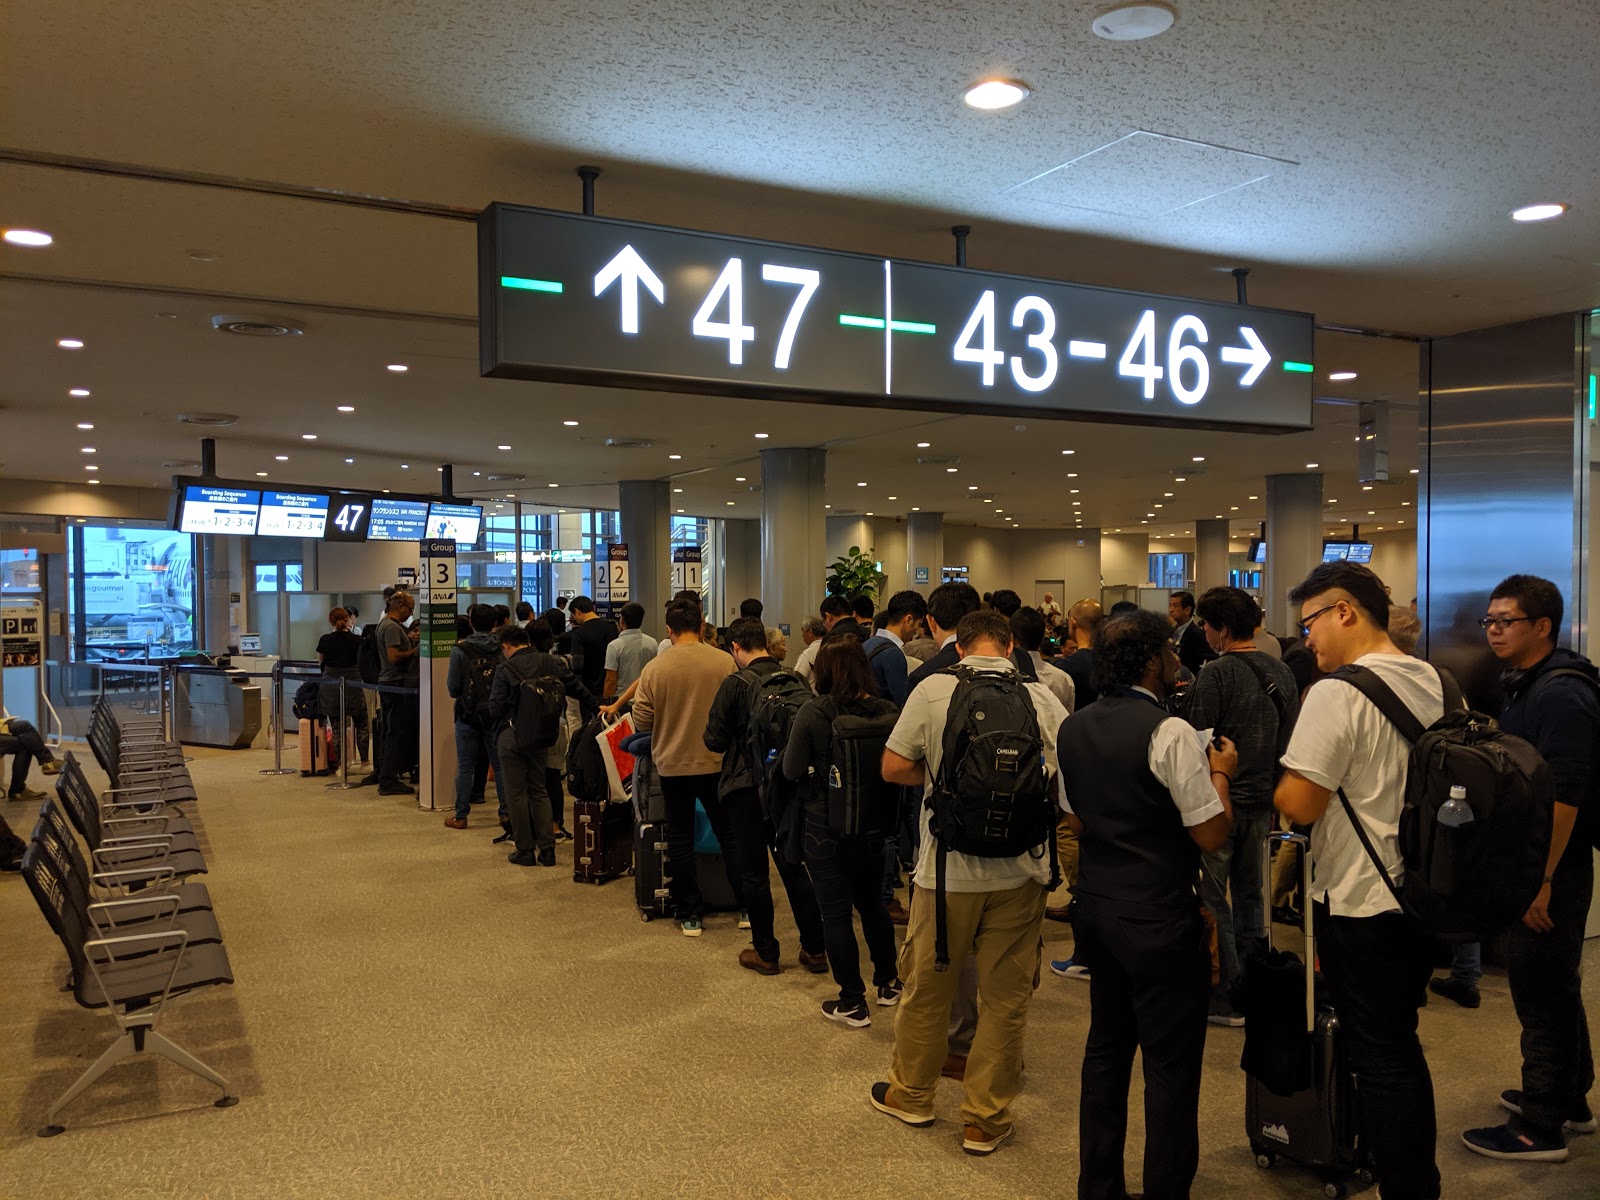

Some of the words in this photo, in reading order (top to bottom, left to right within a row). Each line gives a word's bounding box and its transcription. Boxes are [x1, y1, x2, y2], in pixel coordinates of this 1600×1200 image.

[692, 257, 820, 370] 47
[335, 504, 364, 531] 47
[430, 543, 454, 553] Group
[610, 548, 628, 556] Group
[436, 563, 449, 584] 3
[598, 566, 606, 584] 2
[614, 566, 624, 584] 2
[690, 567, 696, 584] 1
